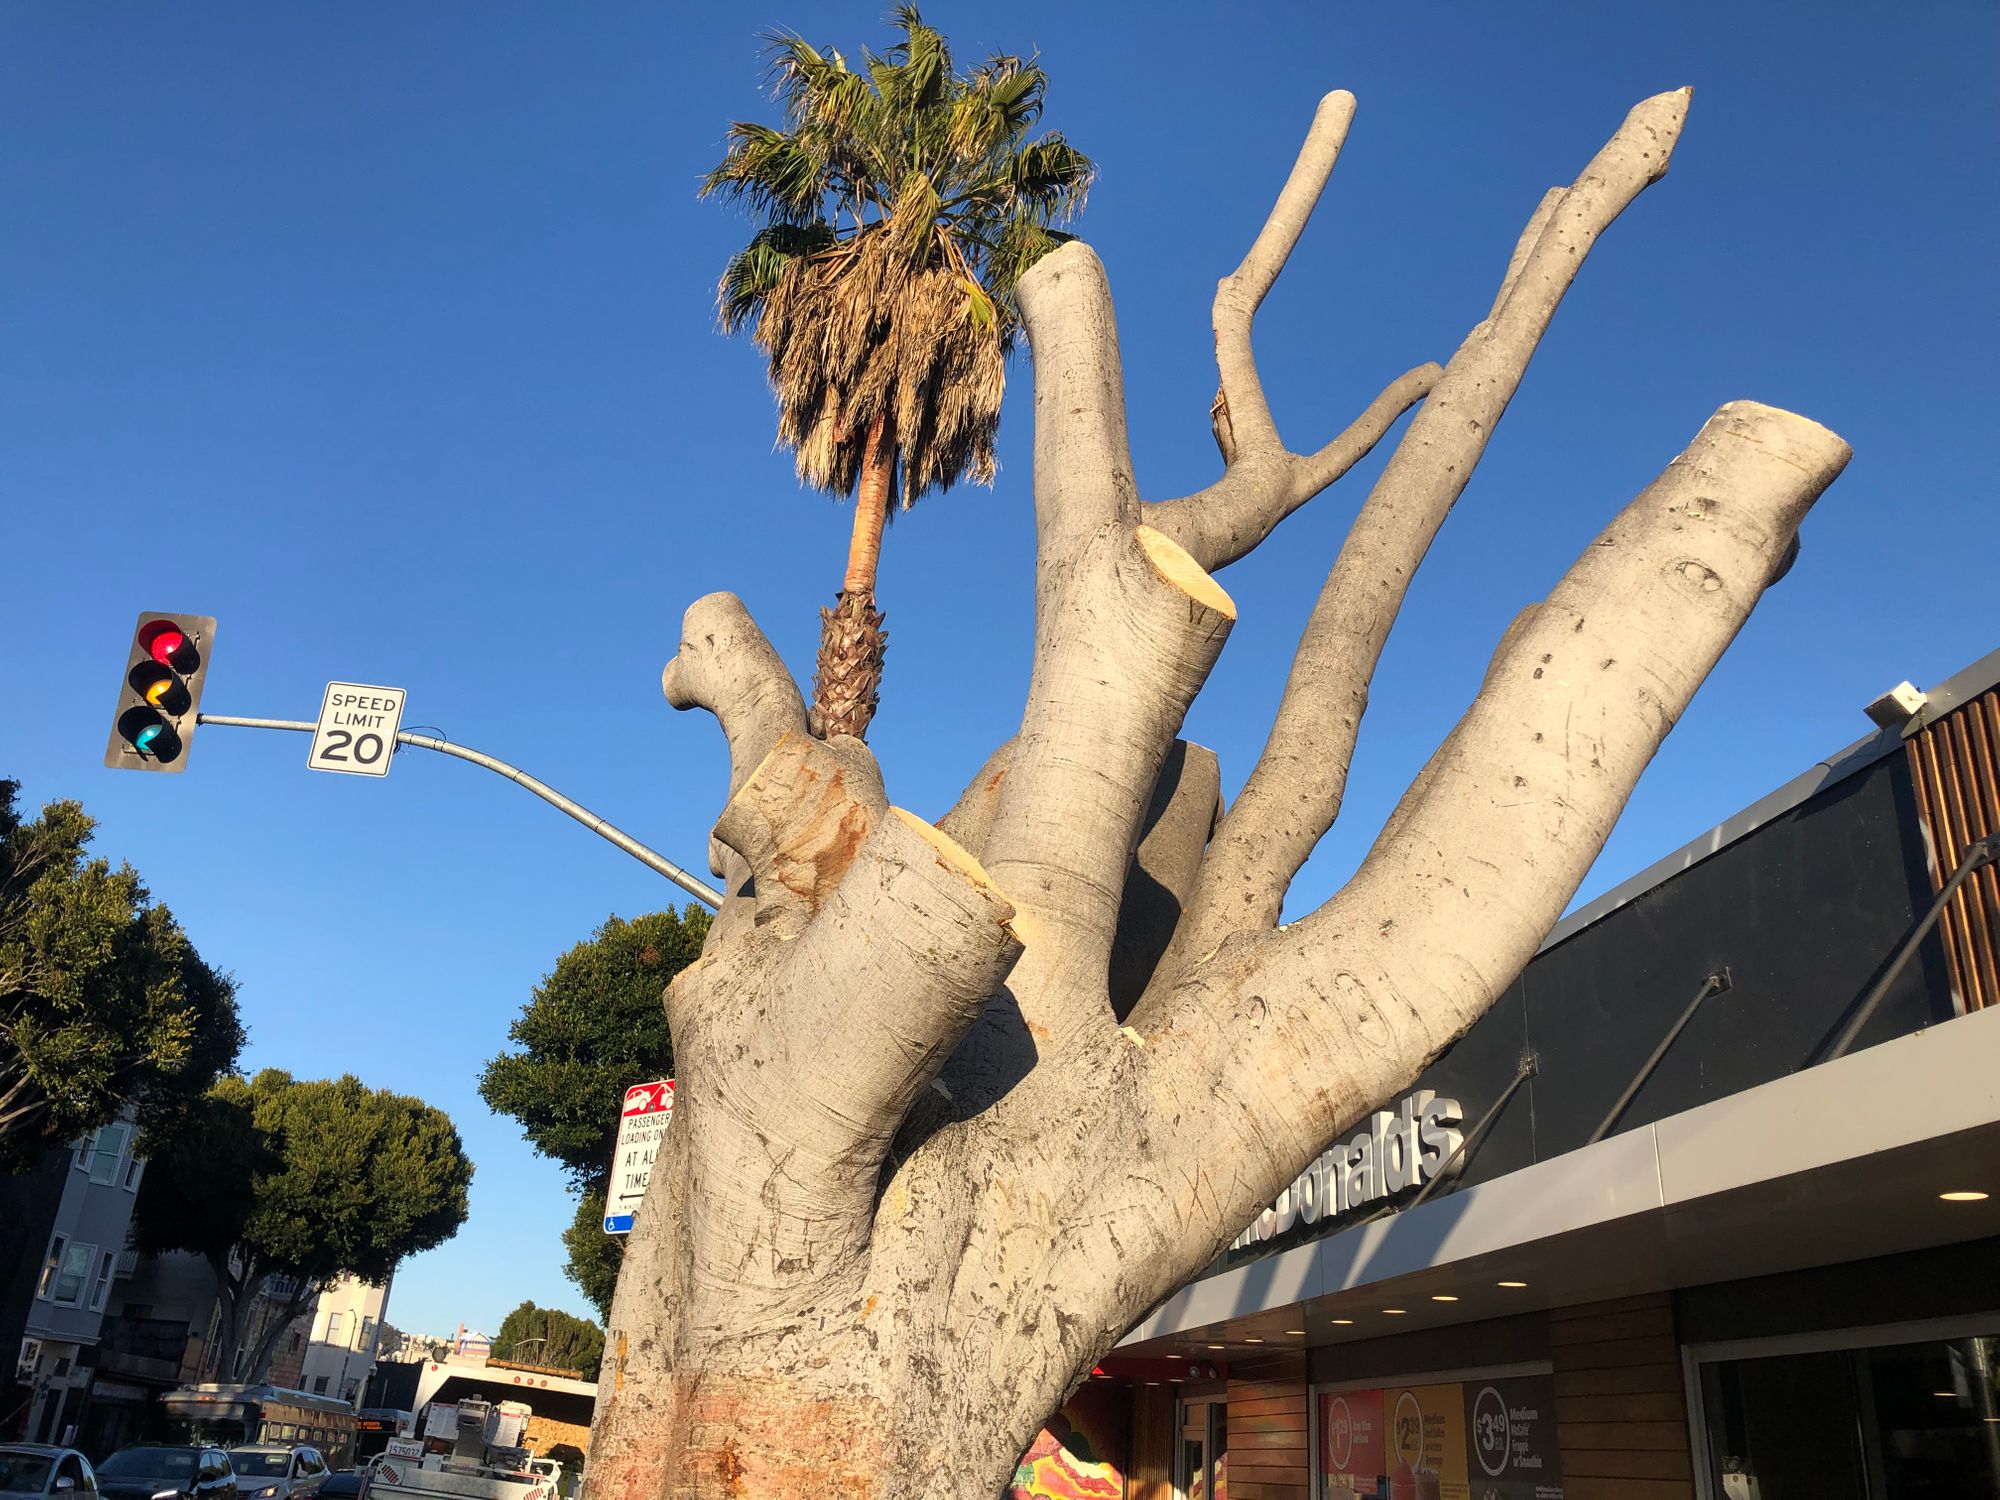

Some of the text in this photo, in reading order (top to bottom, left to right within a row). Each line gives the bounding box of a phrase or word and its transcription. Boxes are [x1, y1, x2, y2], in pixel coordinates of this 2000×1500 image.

[331, 693, 396, 712] SPEED
[333, 711, 385, 729] LIMIT
[319, 729, 384, 765] 20
[627, 1112, 671, 1130] PASSENGER
[621, 1127, 667, 1146] LOADING ON
[624, 1148, 660, 1168] AT AL
[625, 1171, 651, 1190] TIME
[1509, 1406, 1539, 1421] Medium
